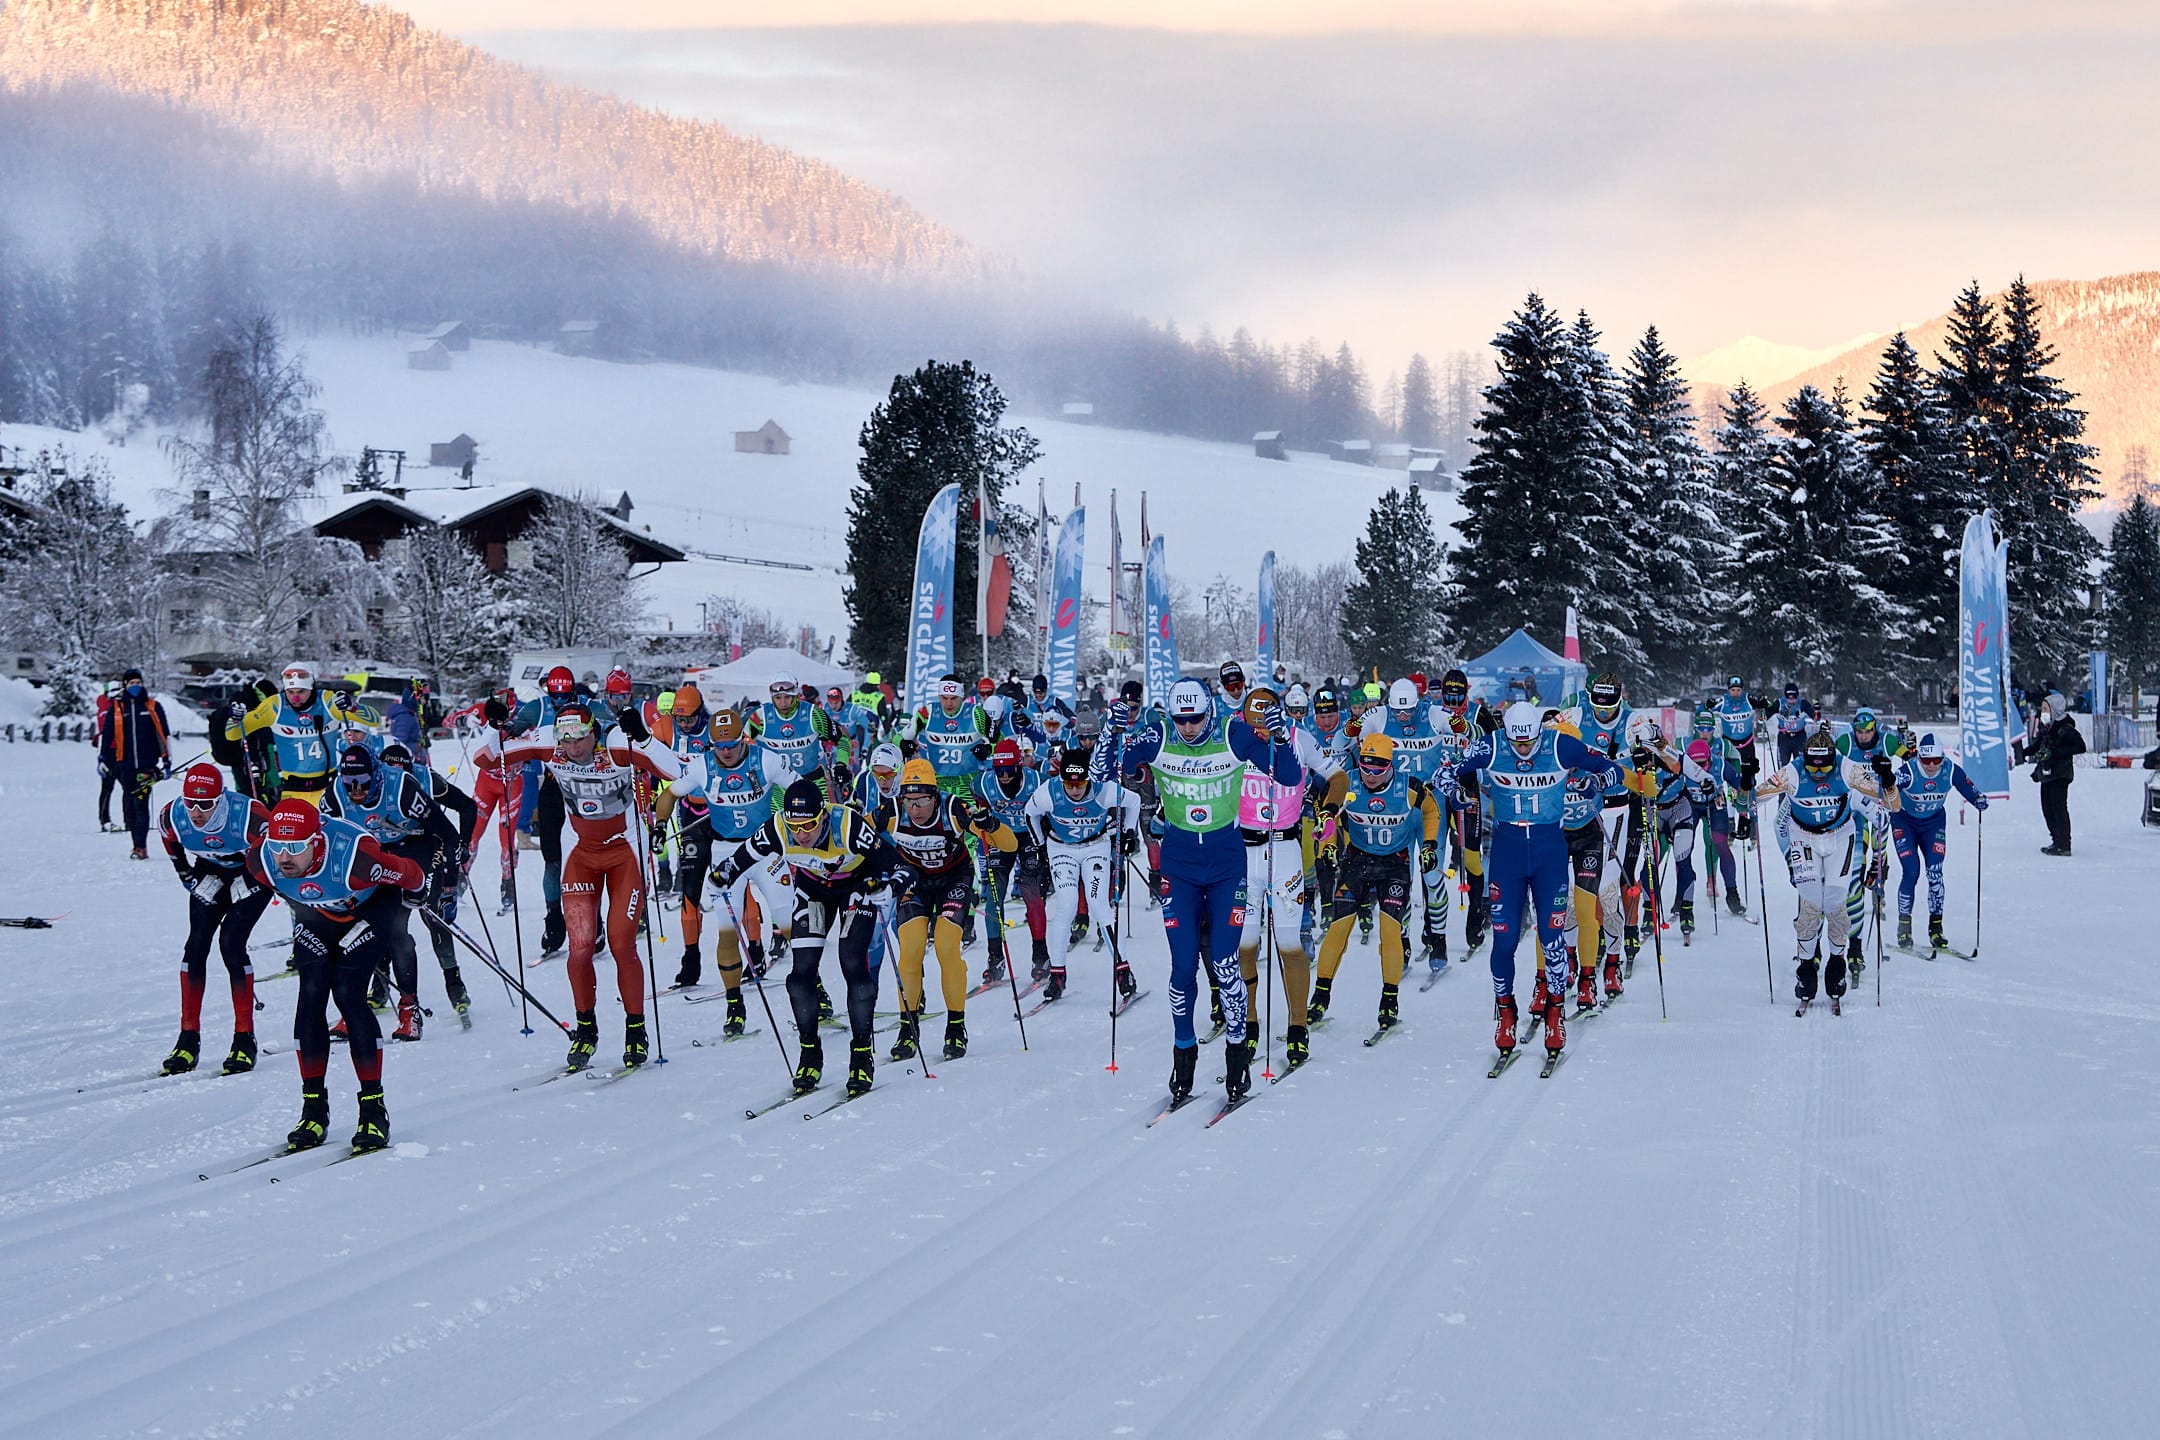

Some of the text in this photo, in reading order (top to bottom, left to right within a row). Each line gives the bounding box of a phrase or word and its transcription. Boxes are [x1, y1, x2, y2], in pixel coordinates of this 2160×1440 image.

[913, 581, 934, 715] SKI CLASSIC
[1148, 604, 1165, 707] SKI CLASSIC
[925, 635, 947, 704] VISM
[1962, 607, 1981, 759] SKI CLASSICS
[1176, 694, 1199, 704] RWT
[1974, 666, 2003, 751] VISMA
[1511, 724, 1533, 734] RWT
[1730, 722, 1745, 734] 78
[782, 738, 812, 748] VISMA
[943, 735, 973, 744] VISMA
[1402, 739, 1433, 749] VISMA
[293, 739, 323, 762] 14
[938, 748, 963, 765] 29
[1397, 754, 1422, 773] 21
[1160, 774, 1235, 801] SPRINT
[1515, 775, 1556, 787] VISMA
[407, 791, 428, 819] 157
[1511, 793, 1539, 815] 11
[1563, 804, 1588, 820] 23
[1914, 802, 1938, 813] 34
[732, 810, 748, 829] 5
[1368, 815, 1405, 826] VISMA
[856, 821, 876, 850] 157
[1068, 826, 1096, 839] 20
[1363, 827, 1392, 846] 10
[561, 882, 595, 893] SLAVIA
[626, 887, 640, 921] ATEX
